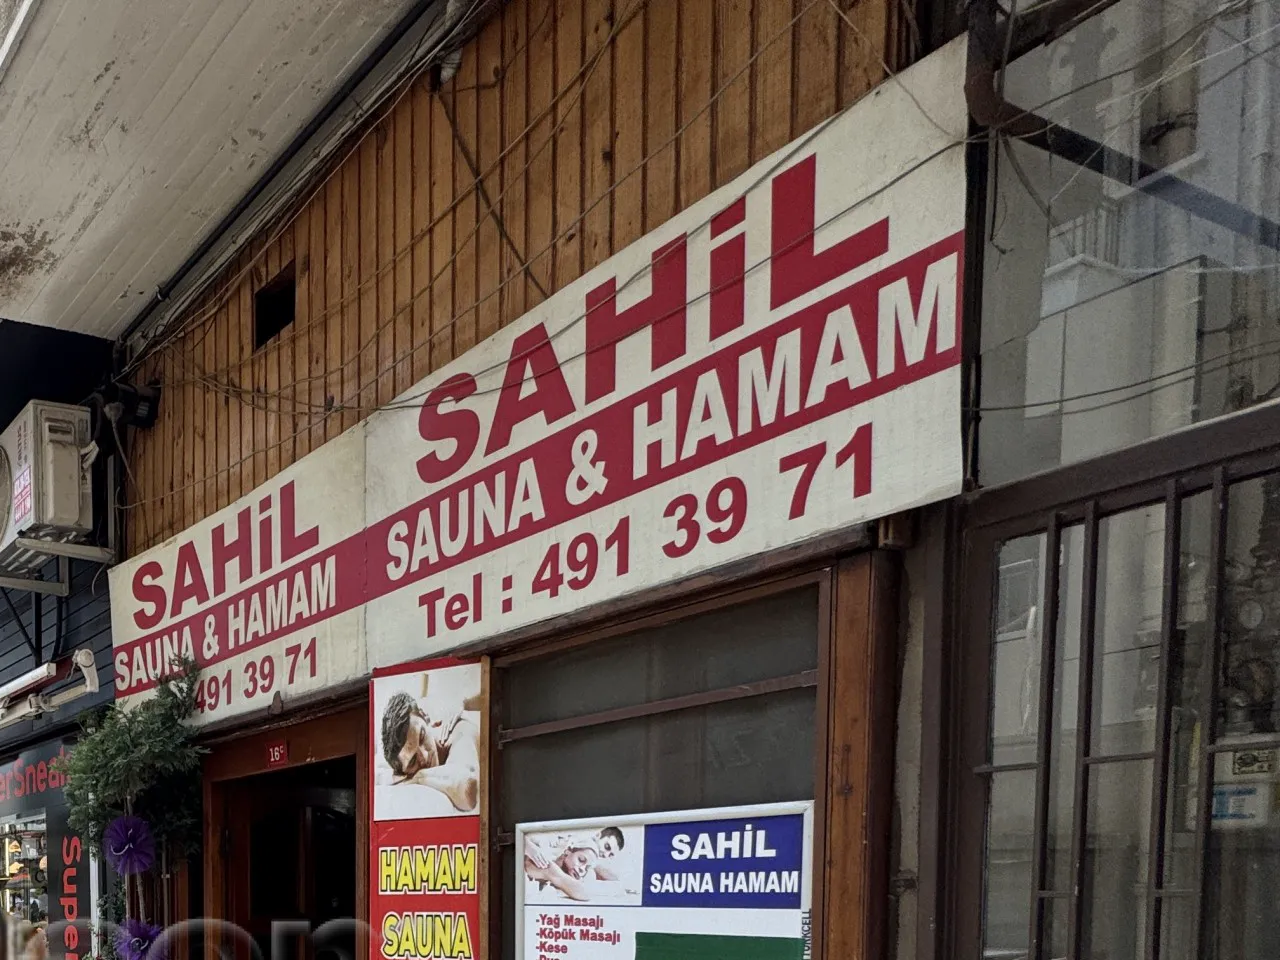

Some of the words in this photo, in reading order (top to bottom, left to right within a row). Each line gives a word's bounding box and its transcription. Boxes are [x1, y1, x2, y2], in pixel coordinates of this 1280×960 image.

[387, 457, 545, 582] SAUNA
[565, 429, 608, 506] &
[632, 251, 959, 480] HAMAM
[531, 516, 630, 599] 491
[662, 476, 748, 558] 39
[779, 422, 873, 520] 71
[114, 626, 195, 691] SAUNA
[202, 614, 220, 660] &
[228, 555, 336, 650] HAMAM
[195, 669, 232, 714] 491
[243, 655, 275, 698] 39
[286, 637, 317, 685] 71
[670, 823, 777, 860] SAHİL
[379, 843, 478, 895] HAMAM
[649, 872, 714, 894] SAUNA
[720, 871, 799, 894] HAMAM
[564, 915, 603, 930] Masajı
[580, 929, 620, 945] Masajı
